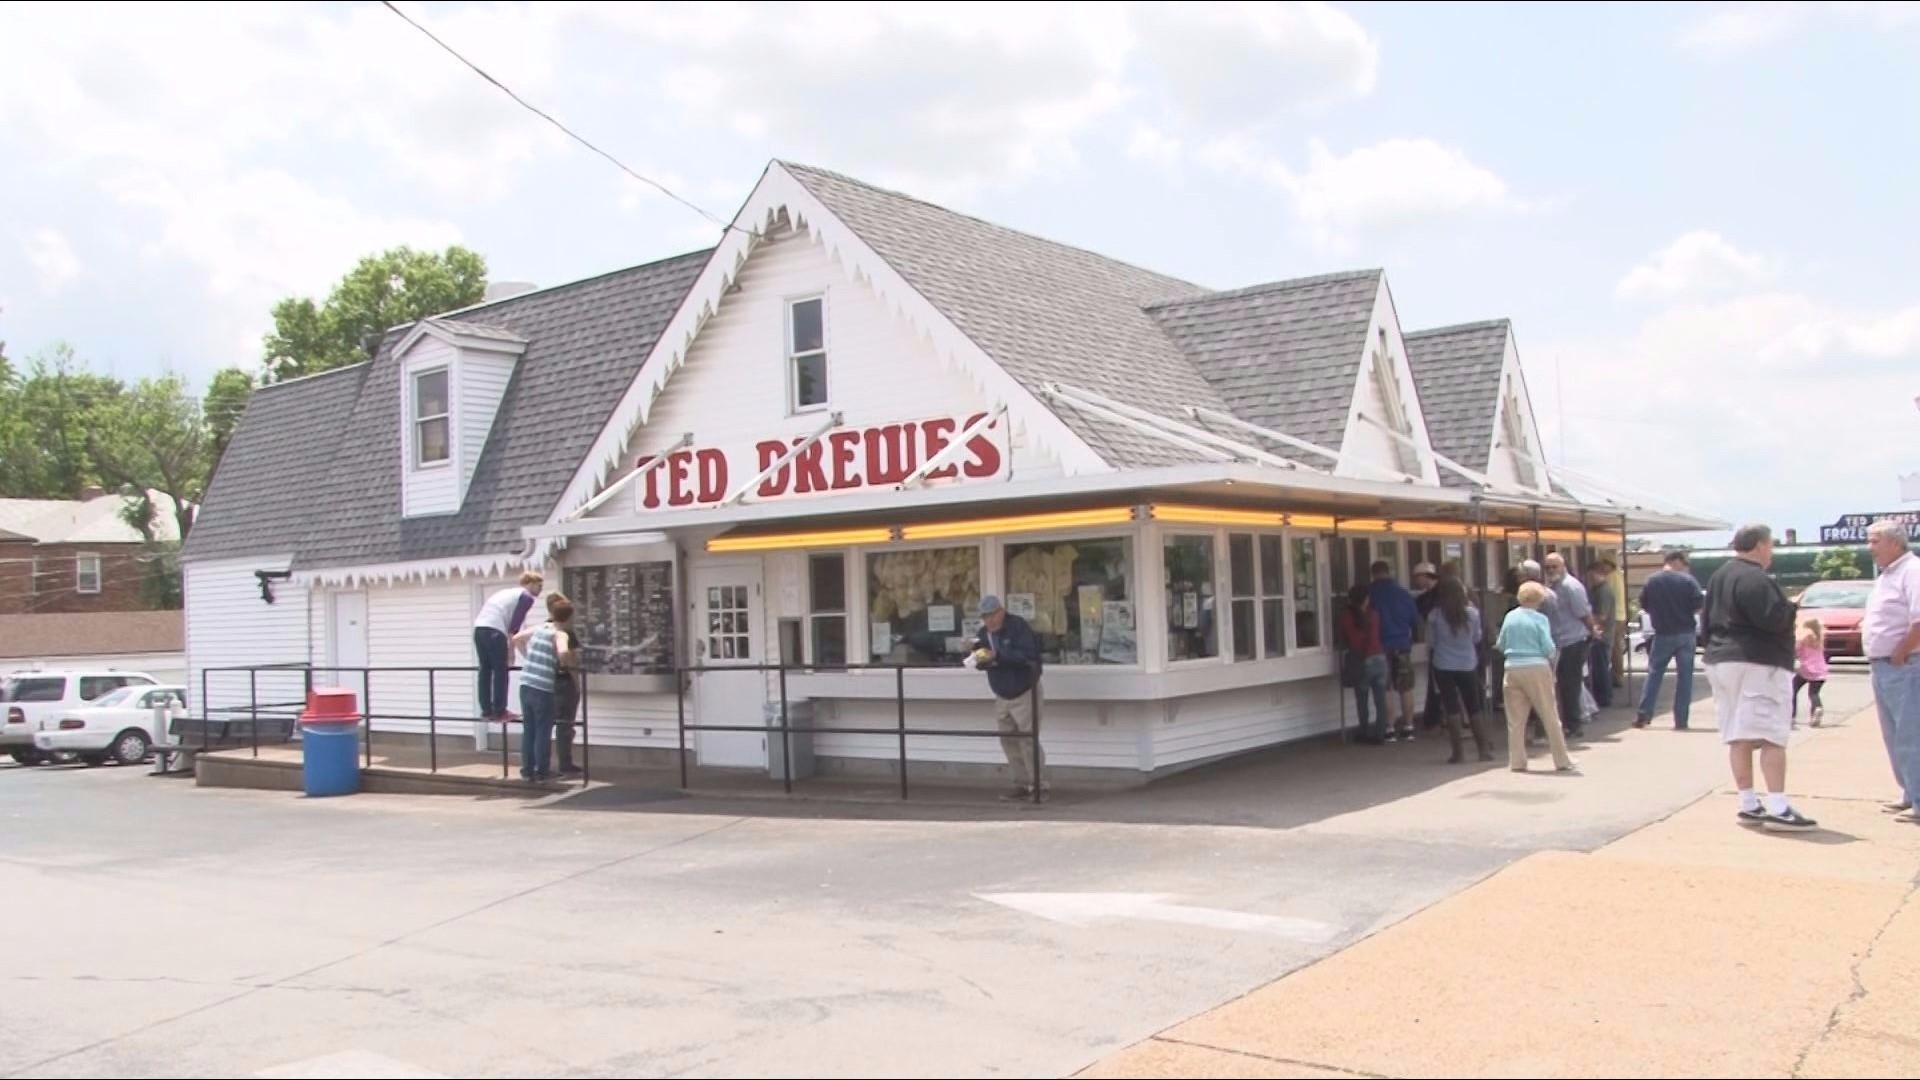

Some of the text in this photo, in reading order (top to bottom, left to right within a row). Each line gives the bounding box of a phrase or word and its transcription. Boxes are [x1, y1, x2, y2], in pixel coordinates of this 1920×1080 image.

[637, 412, 1001, 508] TED DREWES
[1846, 516, 1867, 527] TED
[1824, 527, 1866, 541] FROZE
